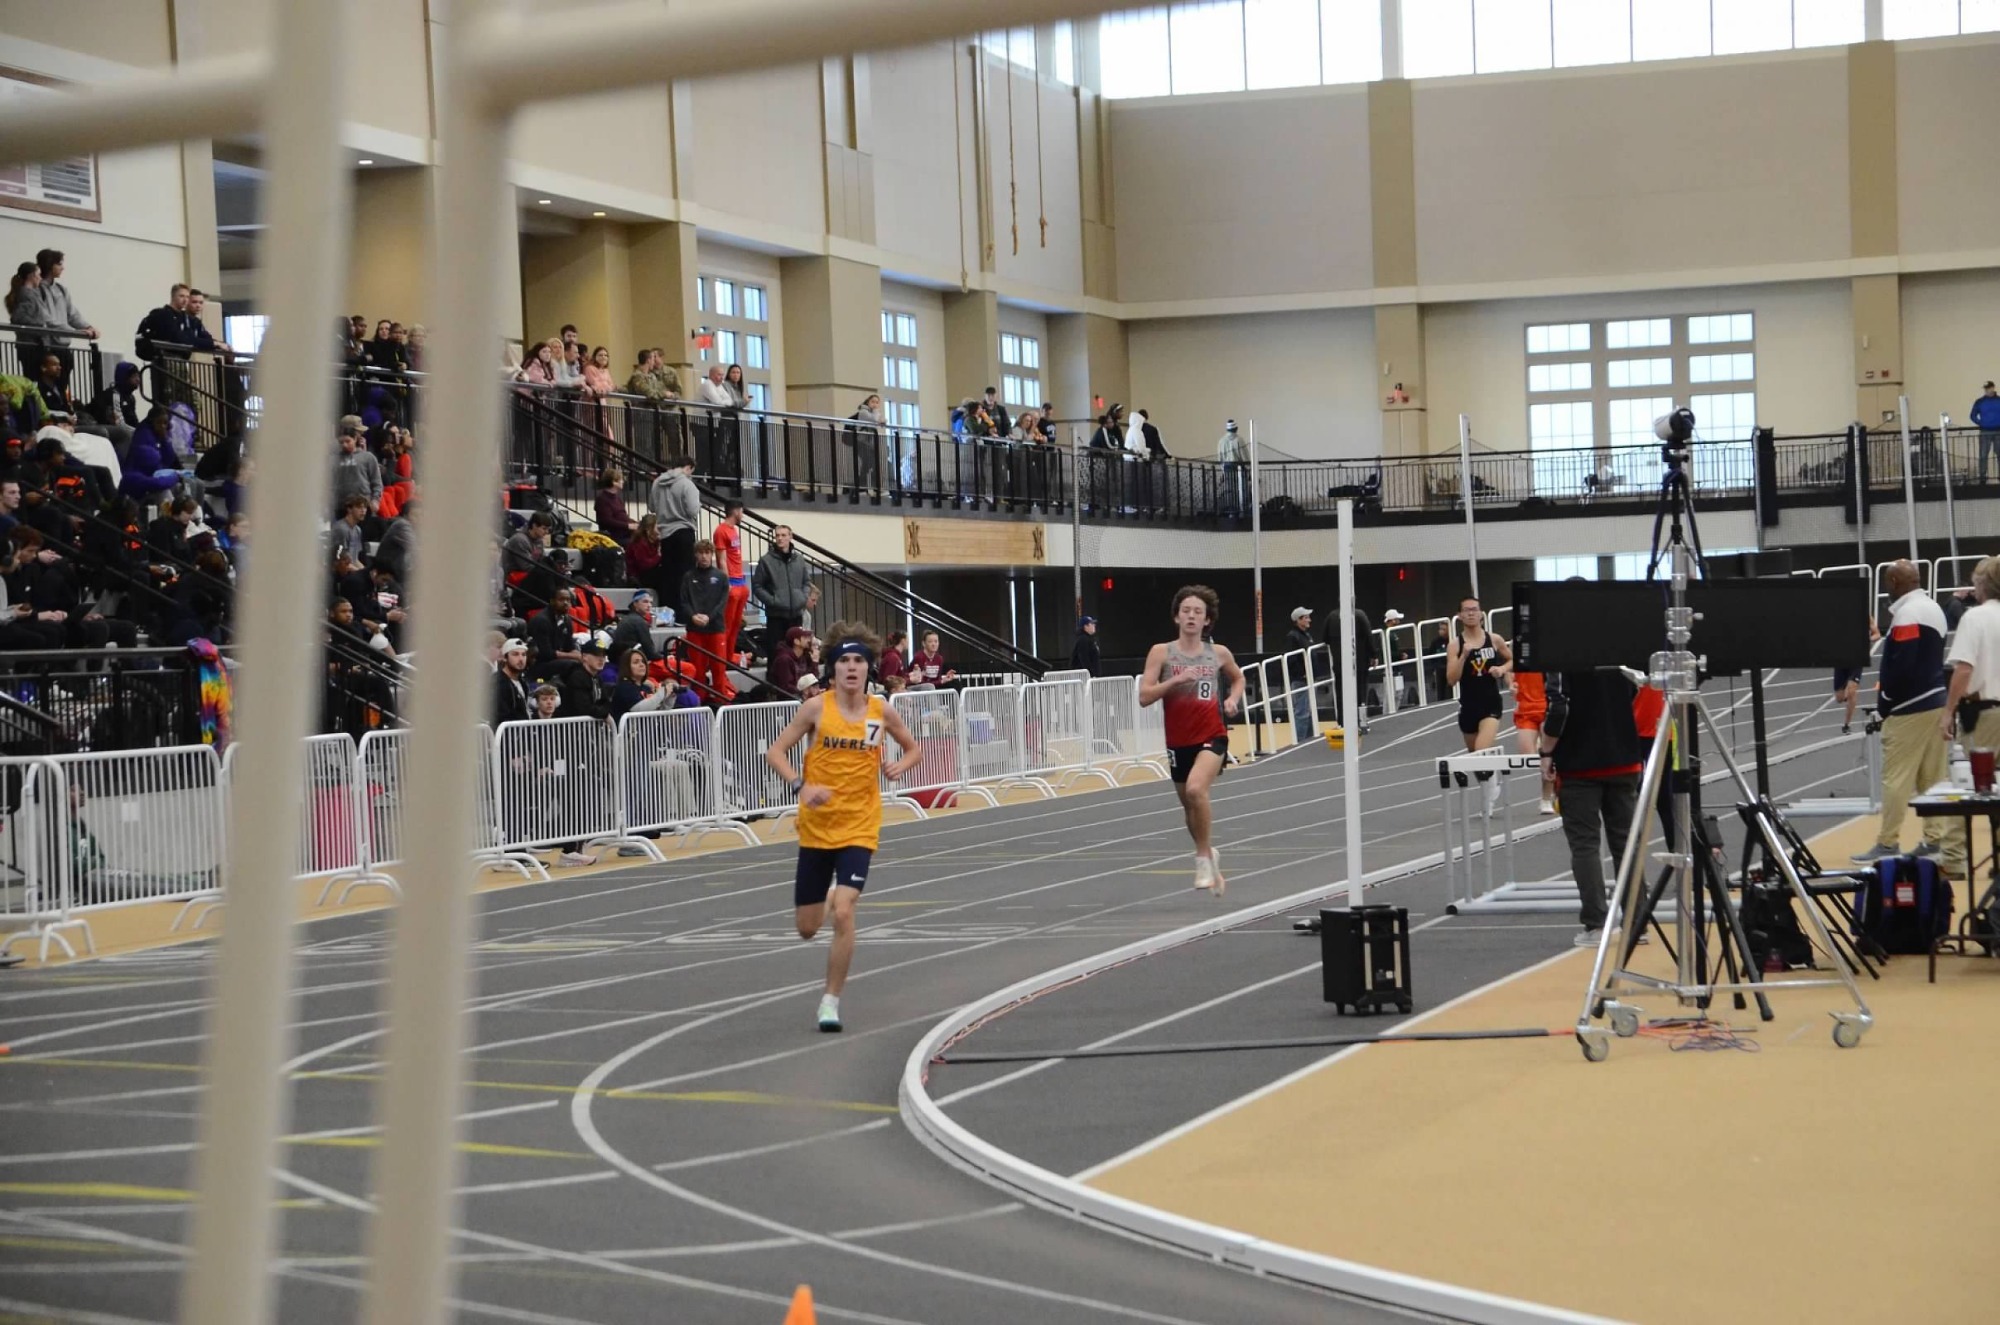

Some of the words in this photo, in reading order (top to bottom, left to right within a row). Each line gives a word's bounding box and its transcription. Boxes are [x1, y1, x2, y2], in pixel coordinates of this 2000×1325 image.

[1200, 682, 1210, 699] 8
[867, 723, 880, 741] 7
[823, 735, 878, 751] AVERE
